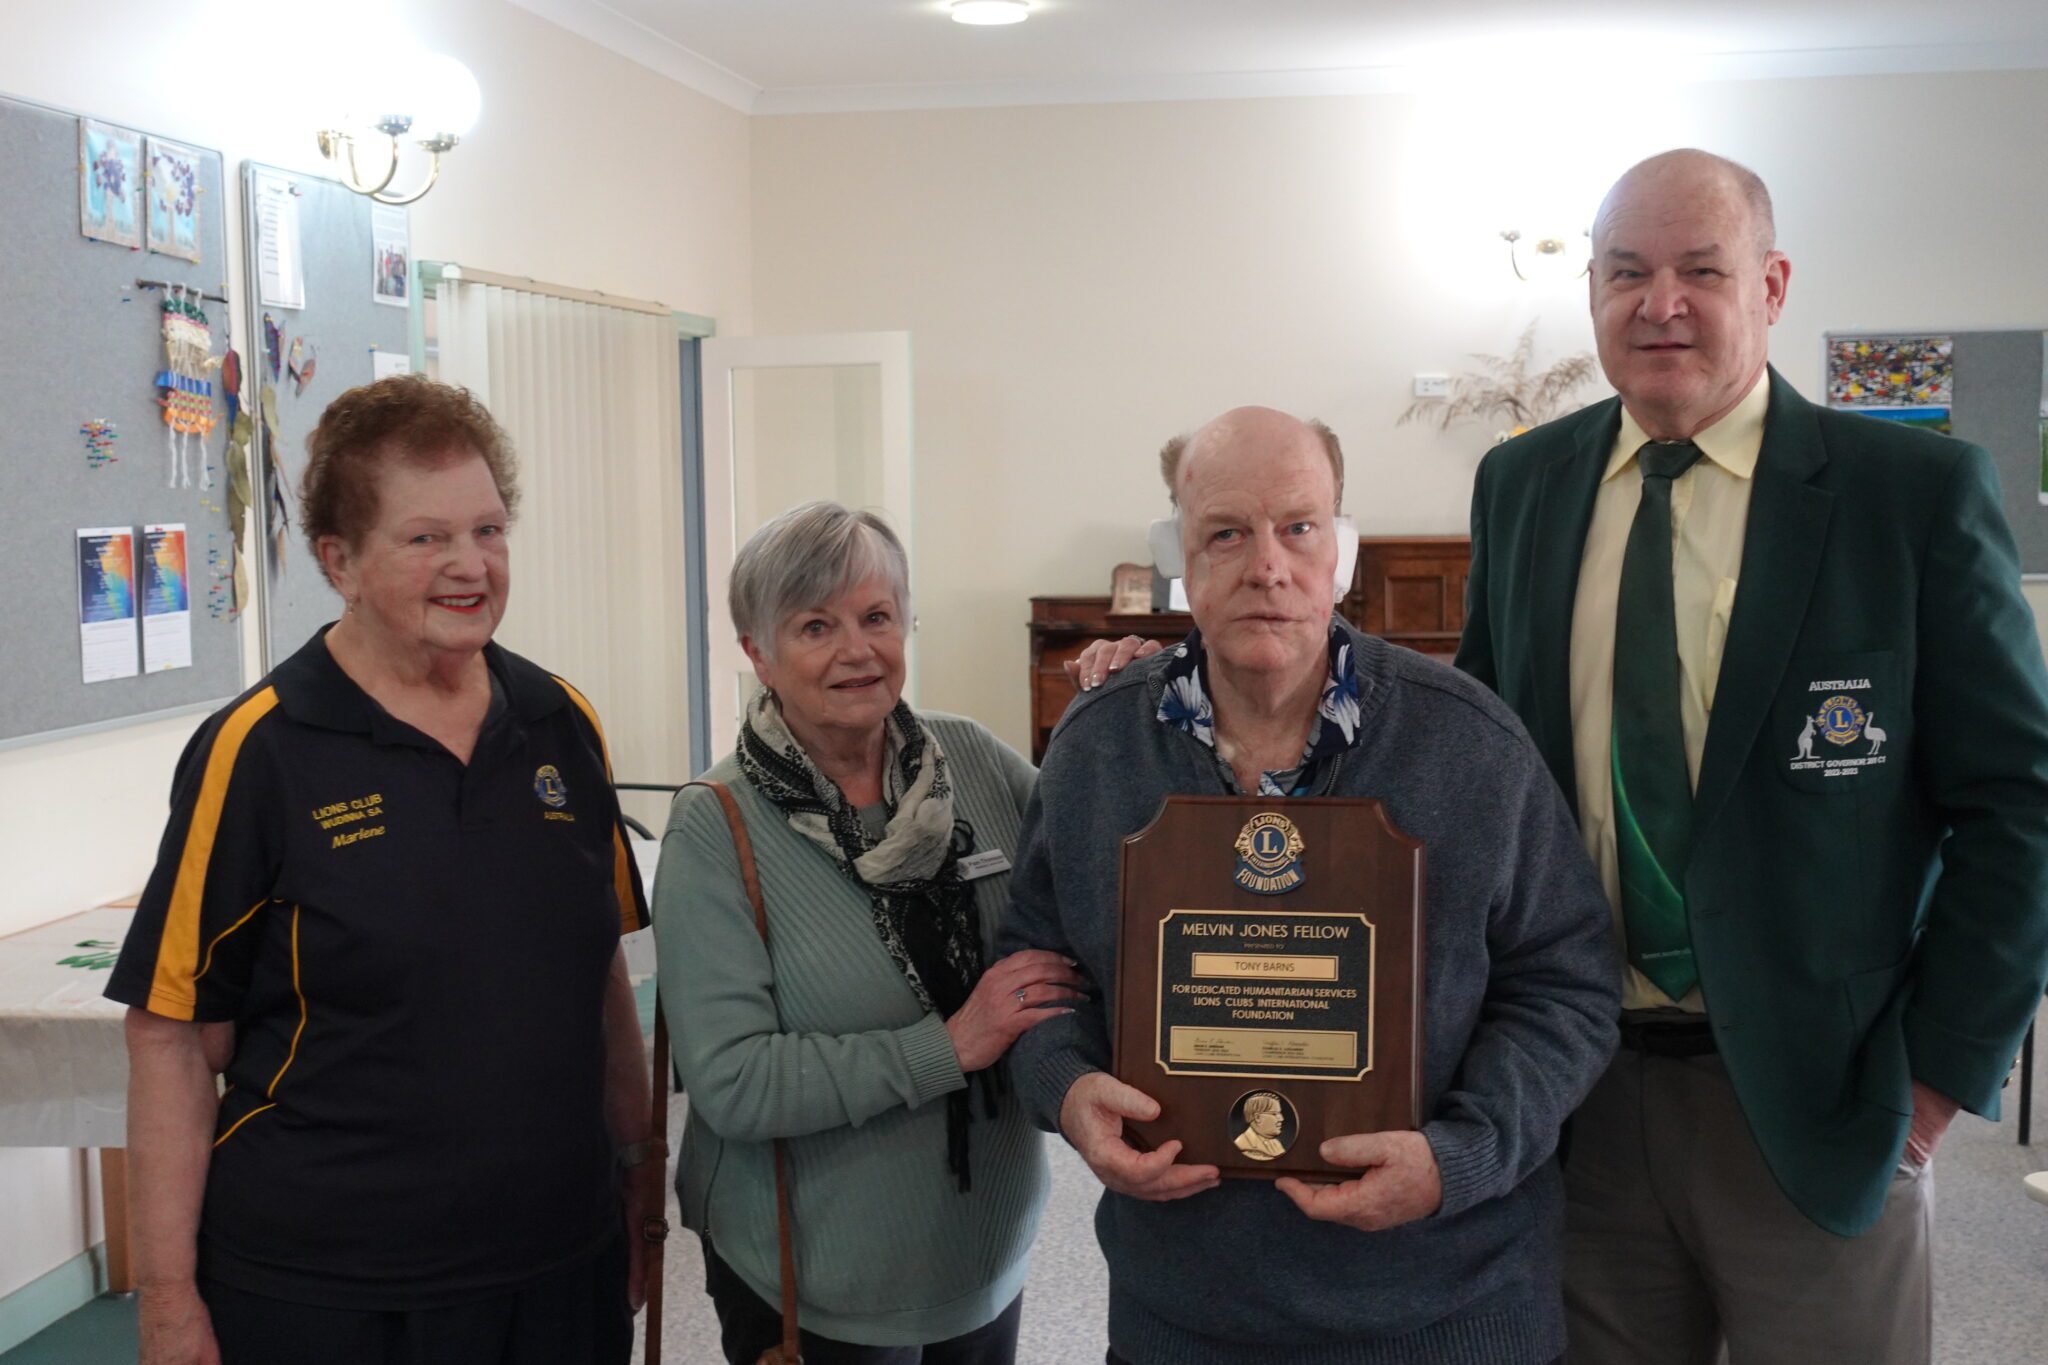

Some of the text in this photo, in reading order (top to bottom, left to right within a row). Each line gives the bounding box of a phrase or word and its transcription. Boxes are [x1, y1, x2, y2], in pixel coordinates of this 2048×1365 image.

[1808, 679, 1872, 691] AUSTRALIA
[1834, 710, 1849, 728] L
[1790, 761, 1825, 770] DISTRICT
[1826, 758, 1866, 768] GOVERNOR
[544, 778, 558, 795] L
[312, 793, 383, 820] LIONS CLUB
[367, 806, 384, 817] SA
[1254, 815, 1286, 828] LIONS
[332, 825, 386, 849] Marlene
[1260, 831, 1279, 854] L
[1236, 868, 1300, 892] FOUNDATION
[1182, 923, 1350, 939] MELVIN JONES FELLOW
[1235, 961, 1295, 973] TONY BARNS
[1172, 984, 1357, 999] FOR DEDICATED HUMANITARIAN SERVICES
[1193, 997, 1330, 1010] LIONS CLUBS INTERNATIONAL
[1232, 1010, 1294, 1021] FOUNDATION
